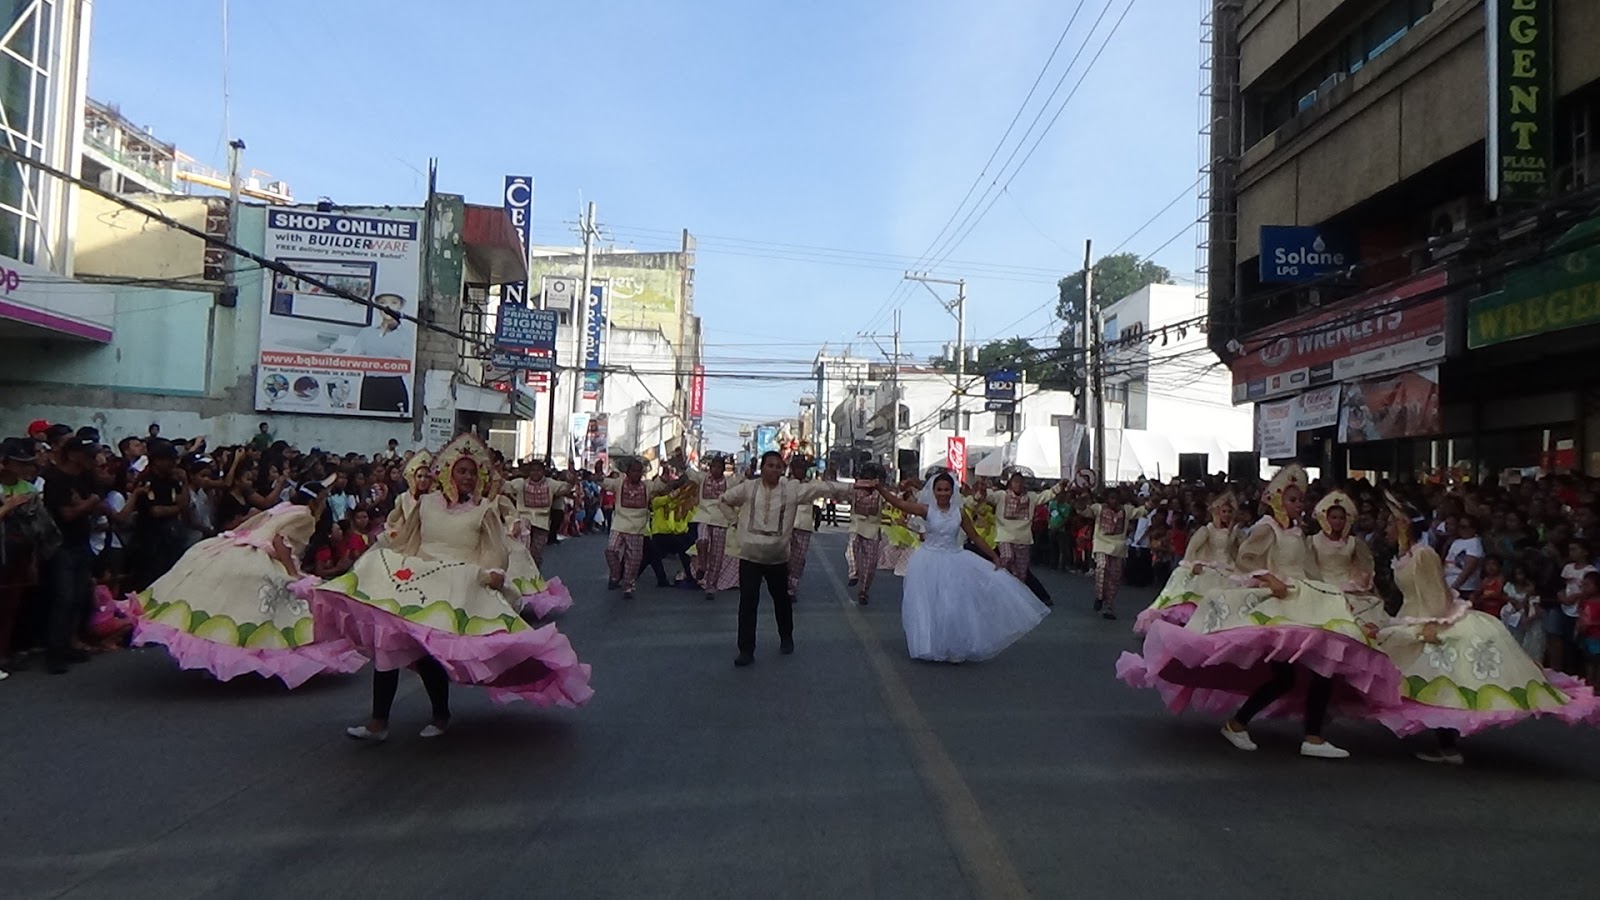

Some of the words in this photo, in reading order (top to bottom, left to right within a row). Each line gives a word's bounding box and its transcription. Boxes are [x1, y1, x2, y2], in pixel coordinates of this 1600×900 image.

[1502, 156, 1546, 168] PLAZA
[1502, 171, 1546, 183] HOTEL
[274, 213, 331, 230] SHOP
[336, 219, 411, 237] ONLINE
[275, 232, 302, 242] with
[308, 235, 410, 252] BUILDERWARE
[299, 245, 329, 255] delivery
[331, 247, 368, 258] anywhere
[1274, 247, 1344, 265] Solane
[1276, 266, 1299, 276] LPG
[504, 311, 554, 321] PRINTING
[1478, 281, 1600, 340] WREGE
[502, 317, 552, 330] SIGNS
[503, 327, 553, 336] BILLBOARD
[262, 354, 409, 370] www.bqbuilderware.com
[989, 380, 1013, 390] BDO
